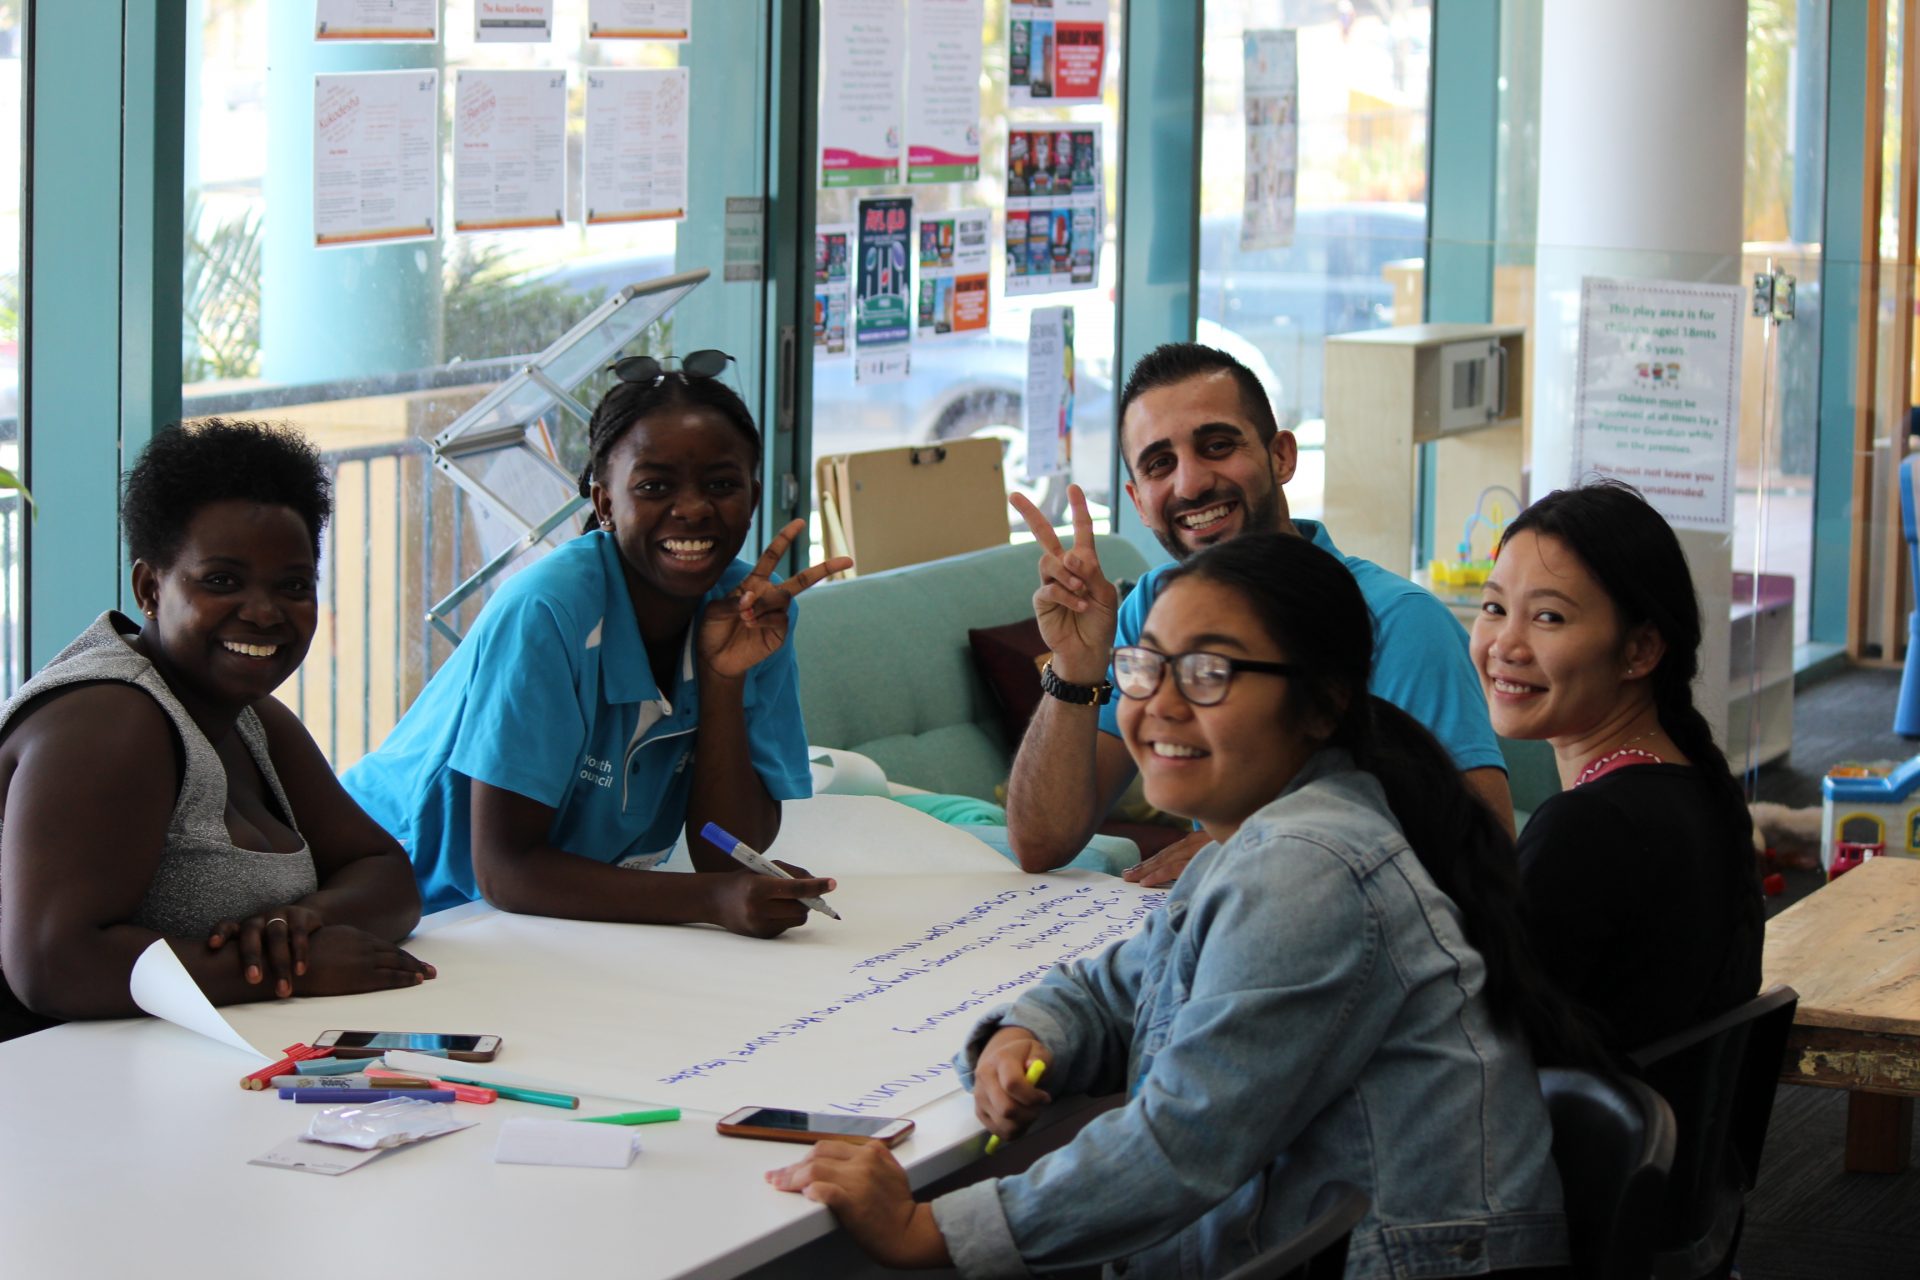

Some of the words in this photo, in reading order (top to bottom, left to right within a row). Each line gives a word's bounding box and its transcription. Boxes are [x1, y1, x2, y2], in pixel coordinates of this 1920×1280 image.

[1608, 303, 1631, 315] This
[1632, 304, 1656, 319] play
[1659, 307, 1685, 319] area
[1687, 308, 1697, 320] is
[1699, 309, 1716, 321] for
[1652, 326, 1680, 338] aged
[1682, 326, 1717, 340] 18mts
[1618, 393, 1657, 405] Children
[1659, 397, 1682, 408] must
[1684, 398, 1697, 409] be
[1647, 411, 1656, 421] at
[1658, 411, 1670, 421] all
[1672, 412, 1697, 423] times
[1699, 414, 1711, 427] by
[1598, 422, 1629, 433] Parent
[1643, 425, 1686, 437] Guardian
[1616, 440, 1629, 449] on
[1631, 440, 1646, 450] the
[1615, 464, 1641, 475] must
[1644, 467, 1662, 478] not
[1664, 468, 1693, 480] leave
[583, 754, 612, 774] Yoth
[579, 768, 613, 788] ouncil
